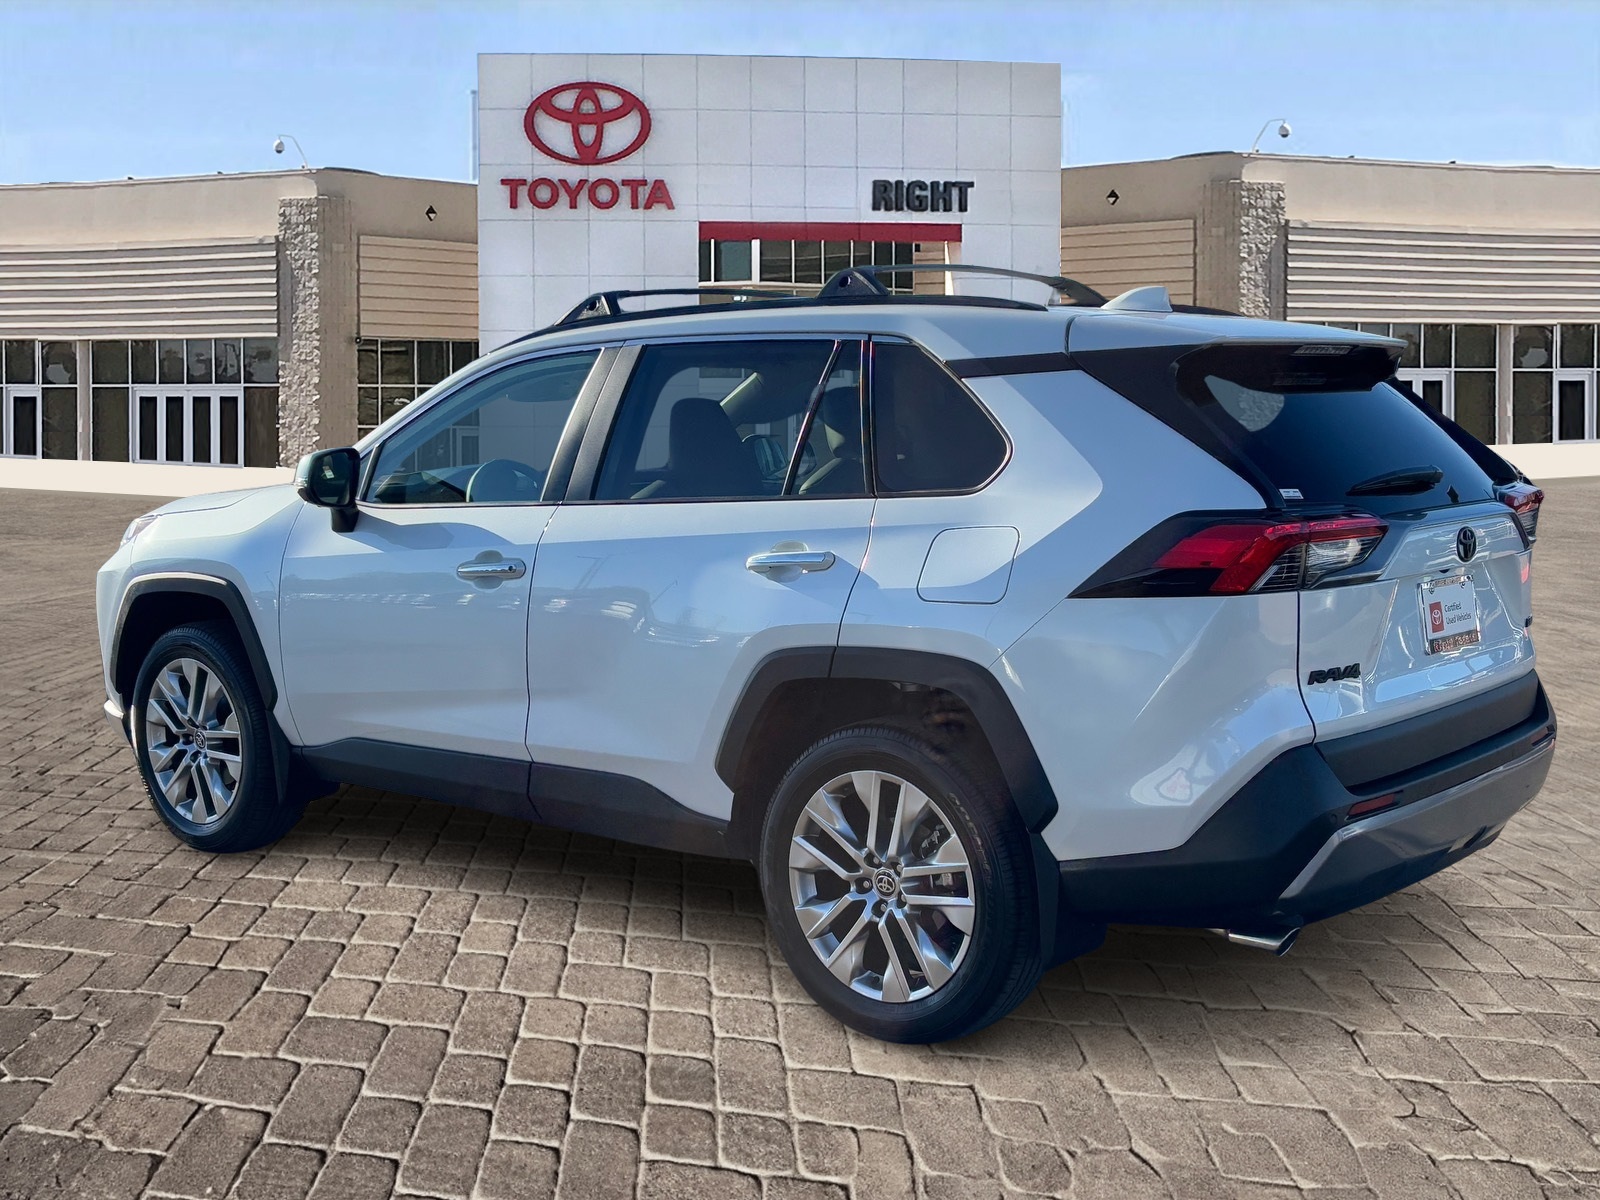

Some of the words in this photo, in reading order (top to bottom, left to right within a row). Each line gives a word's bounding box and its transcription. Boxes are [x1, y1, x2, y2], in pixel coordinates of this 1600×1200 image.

[500, 177, 675, 210] TOYOTA
[872, 180, 975, 212] RIGHT
[1444, 601, 1462, 613] Certified
[1446, 614, 1457, 625] Used
[1456, 612, 1472, 623] Vehicles
[1307, 663, 1361, 685] RAV4
